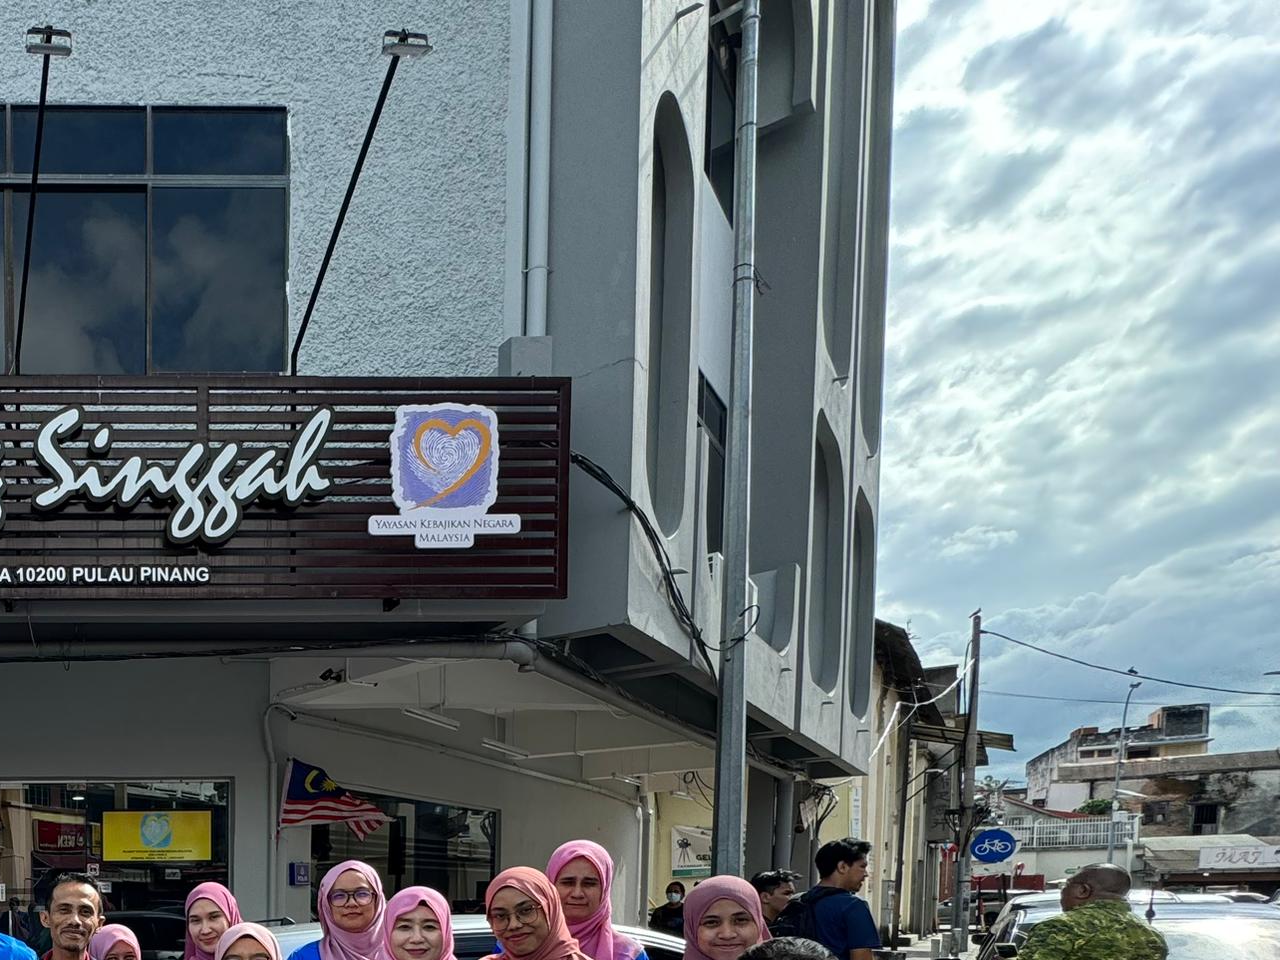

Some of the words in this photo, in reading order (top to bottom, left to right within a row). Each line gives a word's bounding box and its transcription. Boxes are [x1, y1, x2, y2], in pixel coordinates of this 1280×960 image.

[35, 408, 330, 538] Singgah
[375, 519, 417, 529] YAYASAN
[420, 519, 470, 530] KEBAJIKAN
[473, 519, 514, 528] NEGARA
[419, 533, 470, 543] MALAYSIA
[16, 568, 66, 582] 10200
[73, 568, 133, 582] PULAU
[140, 567, 209, 582] PINANG
